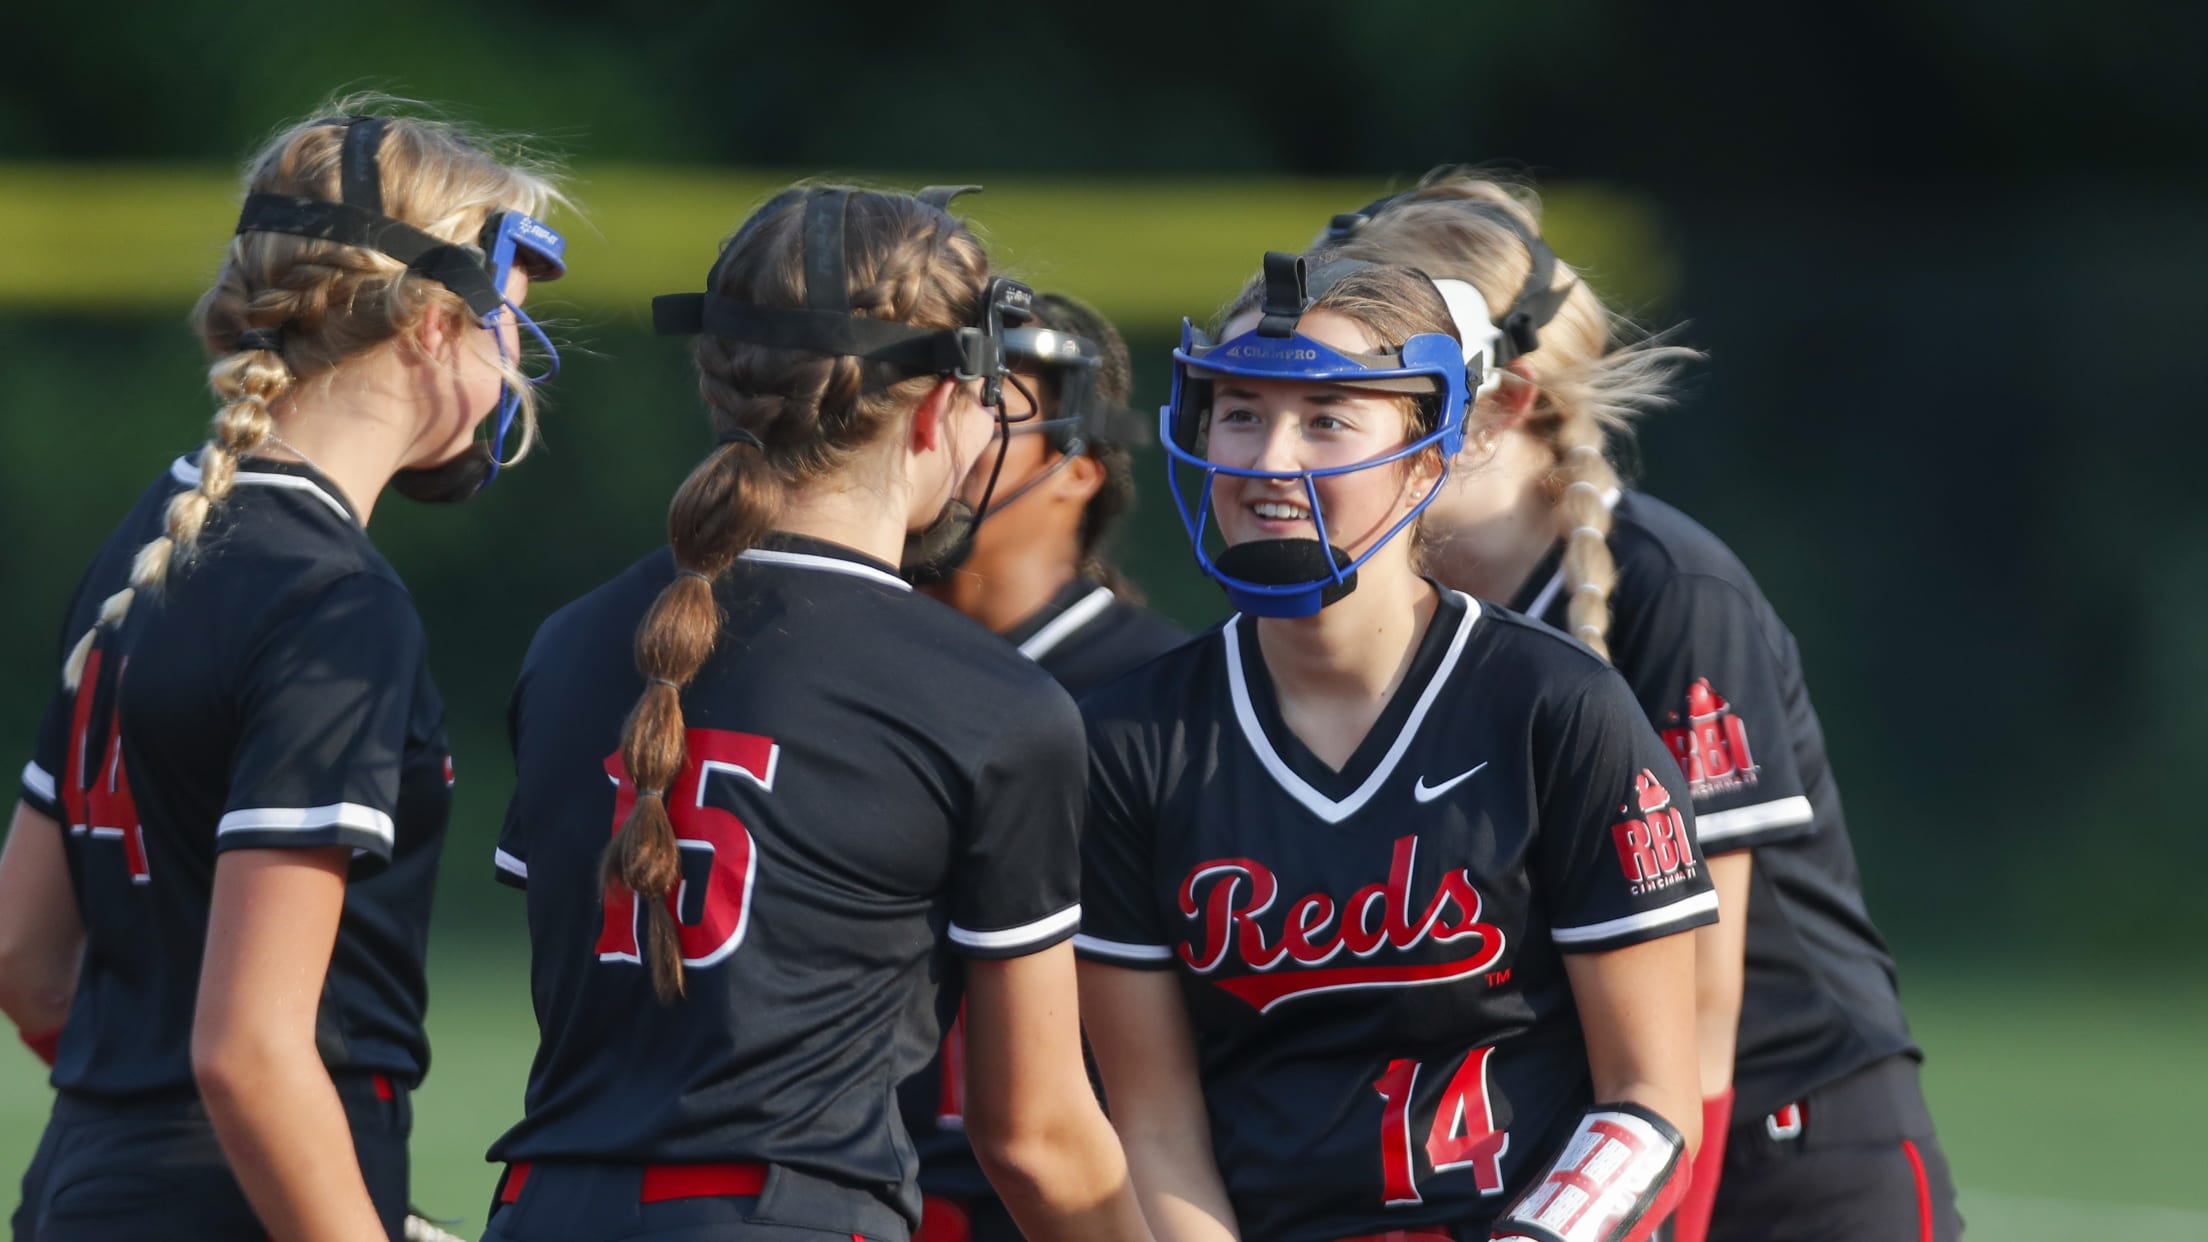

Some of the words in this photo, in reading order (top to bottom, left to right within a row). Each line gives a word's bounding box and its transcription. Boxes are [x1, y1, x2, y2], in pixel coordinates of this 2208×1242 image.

[1611, 807, 1693, 882] RBI
[1178, 833, 1506, 1014] Reds
[1484, 968, 1512, 987] TM
[1373, 1045, 1510, 1206] 14
